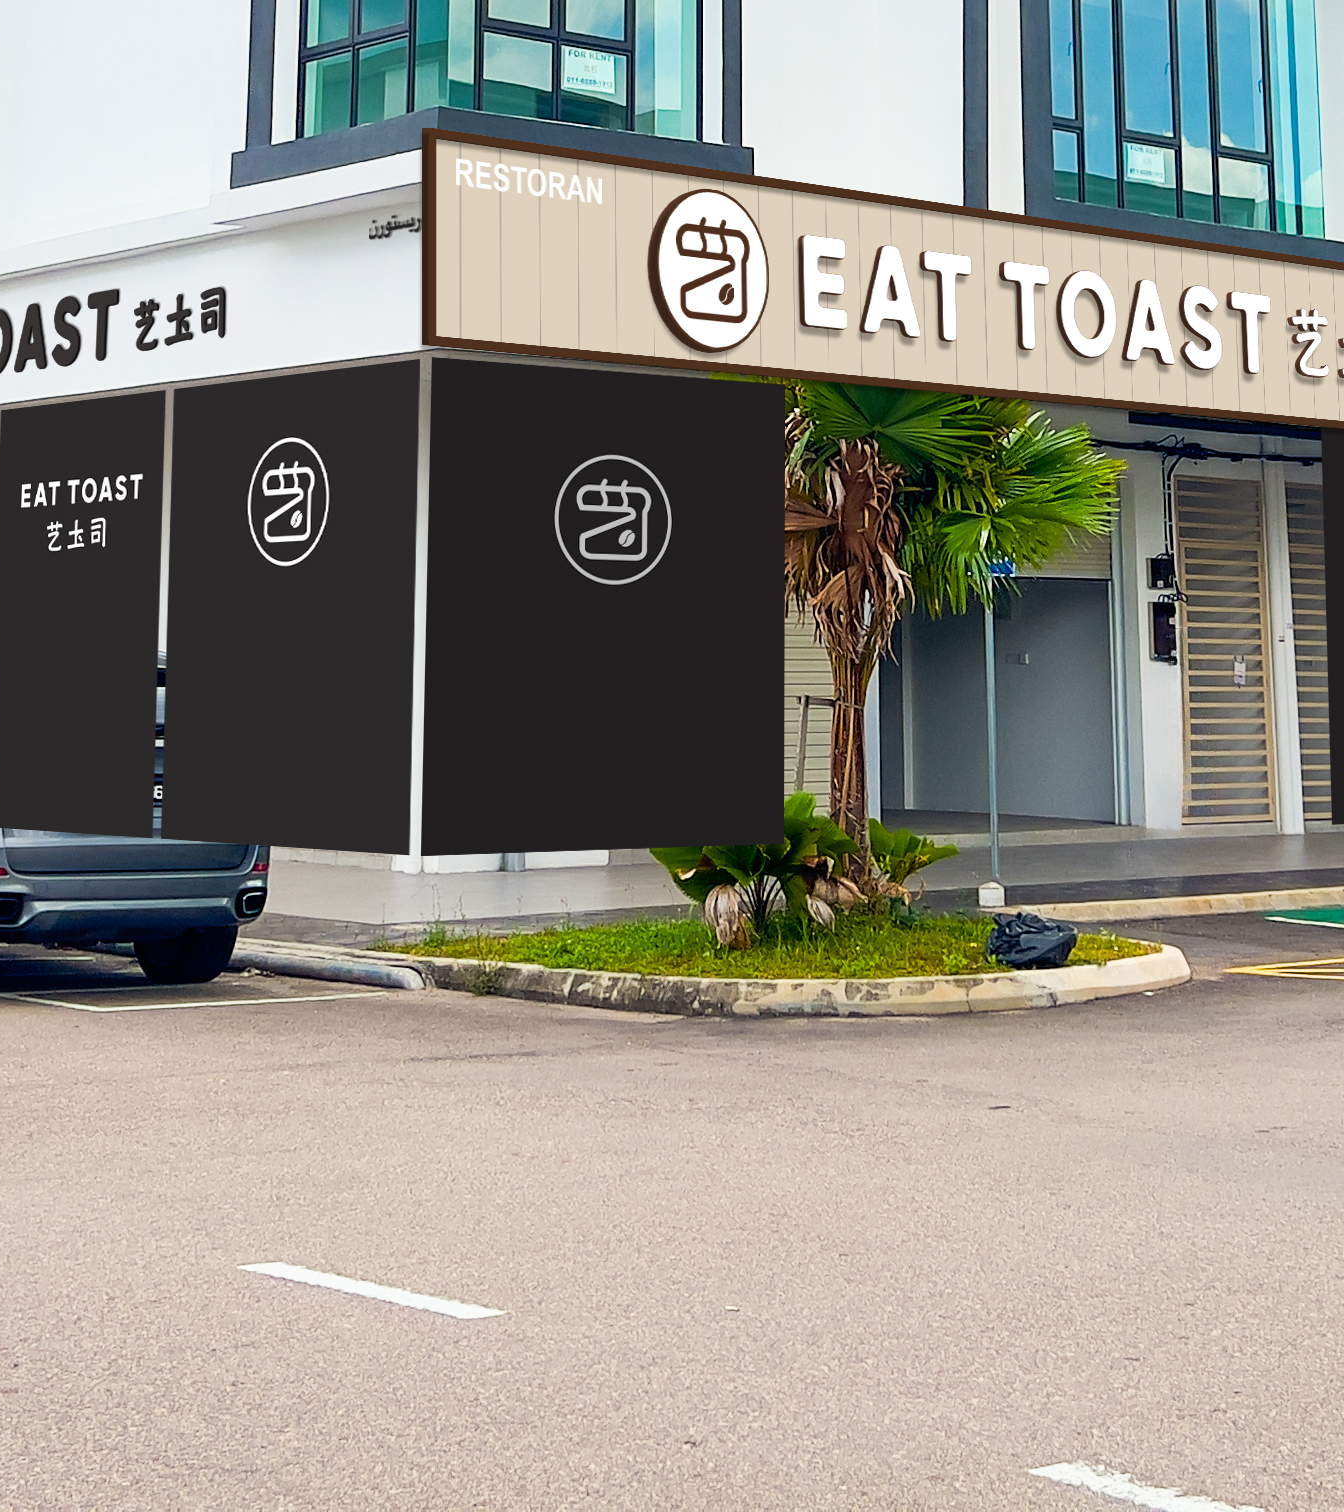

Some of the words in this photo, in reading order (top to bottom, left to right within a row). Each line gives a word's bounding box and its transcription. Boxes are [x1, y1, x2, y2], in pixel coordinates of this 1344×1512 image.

[568, 49, 587, 59] FOR
[589, 52, 611, 62] RENT
[455, 157, 603, 205] RESTORAN
[798, 234, 972, 342] EAT
[999, 260, 1271, 374] TOAST
[20, 481, 61, 508] EAT
[67, 473, 144, 504] TOAST
